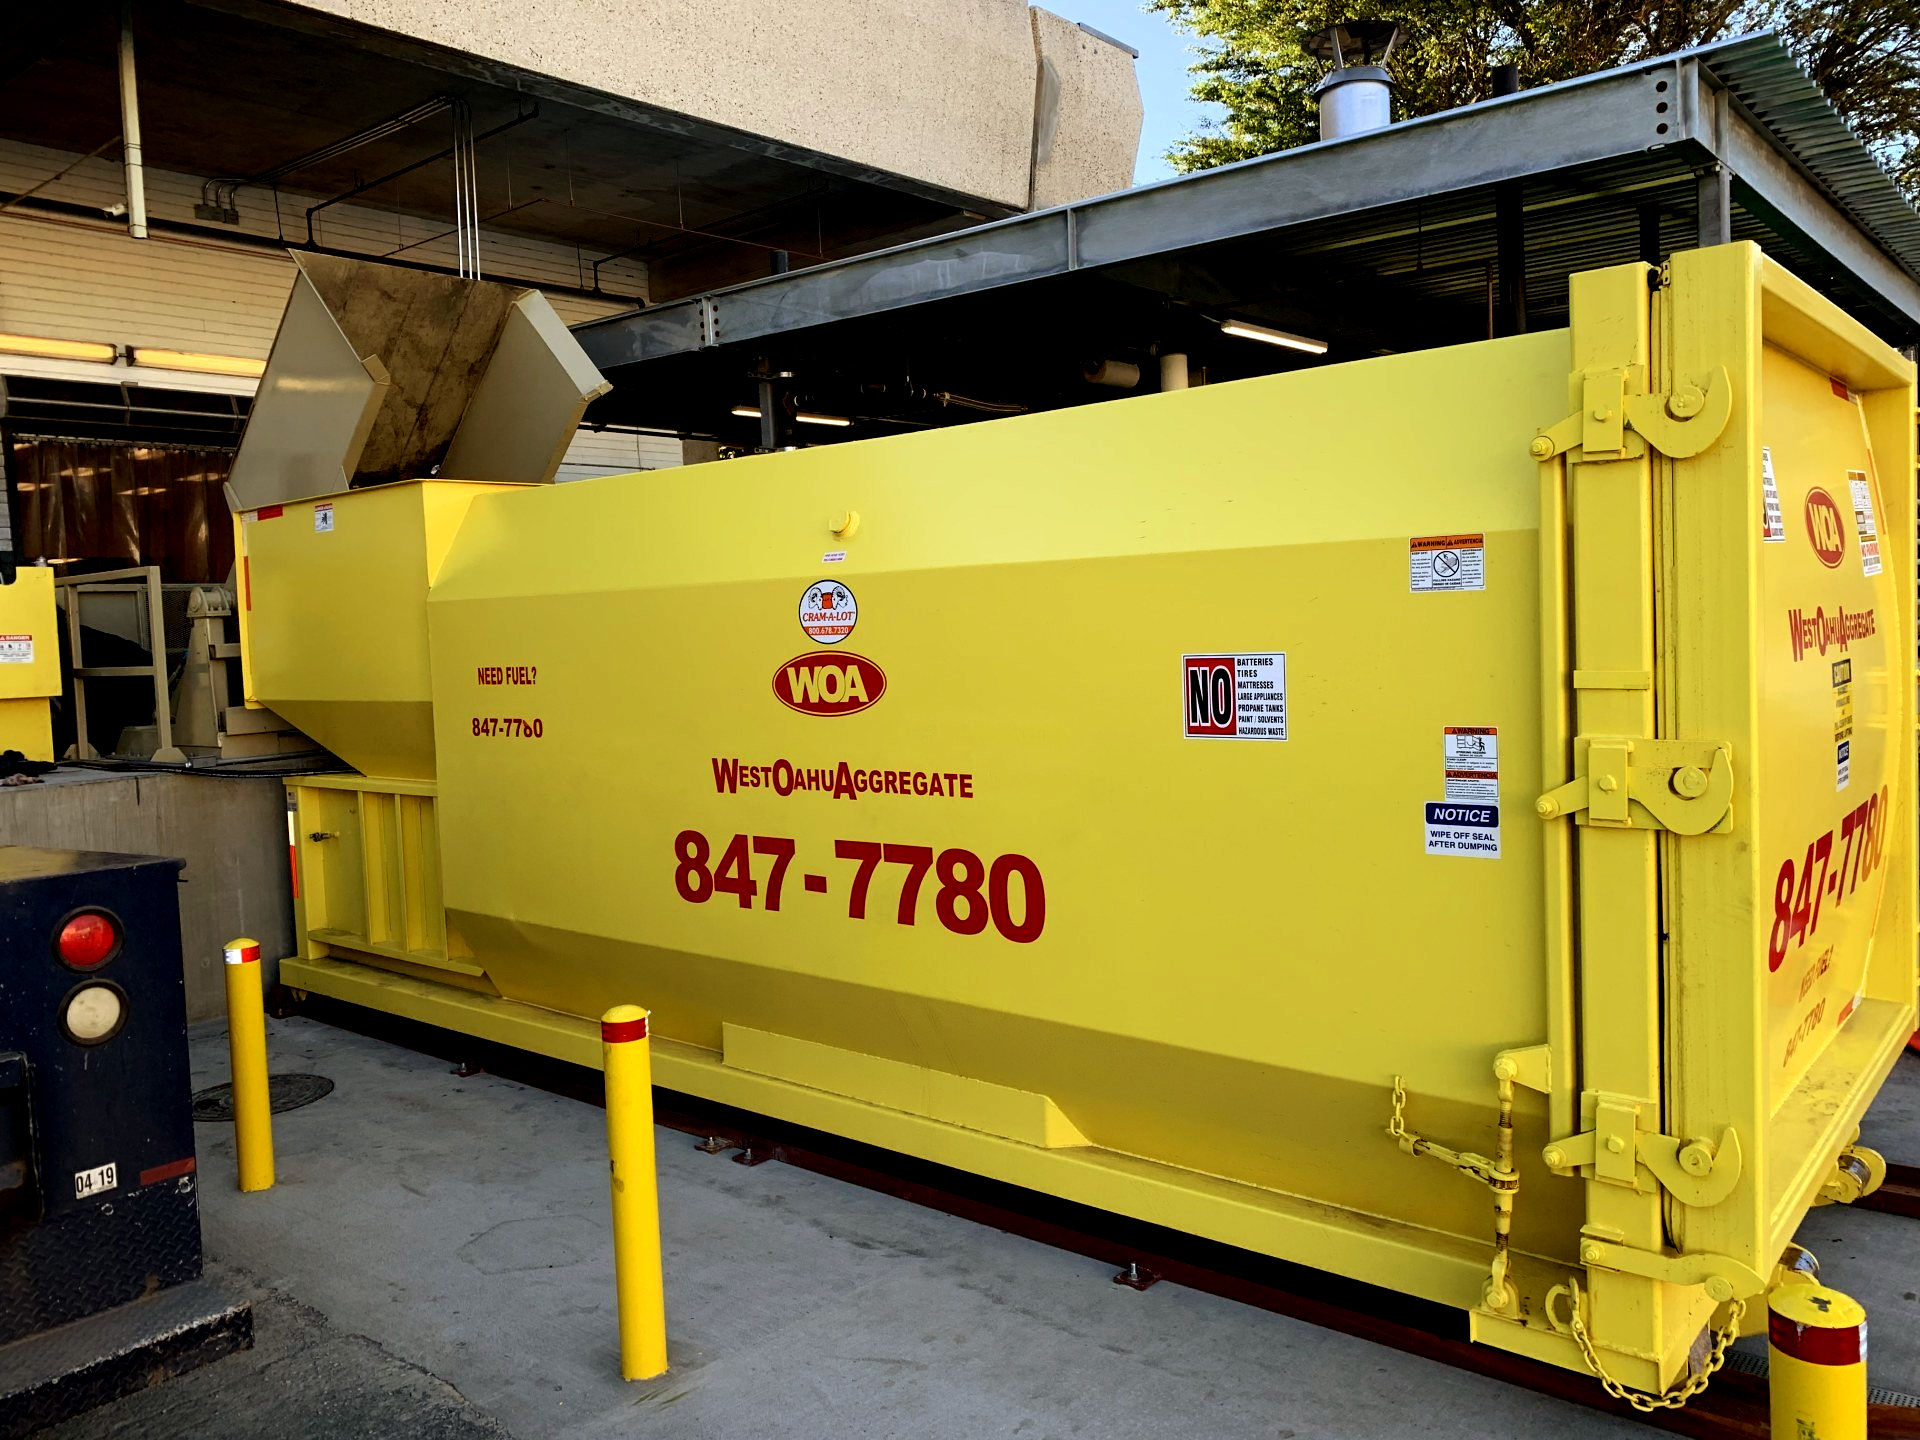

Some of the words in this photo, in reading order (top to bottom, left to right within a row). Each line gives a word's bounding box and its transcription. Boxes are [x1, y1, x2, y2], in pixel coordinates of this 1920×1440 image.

[1808, 502, 1843, 553] WOA
[802, 611, 853, 622] CRAM-A-LOT
[808, 626, 849, 635] 800.678.7320
[1237, 658, 1273, 666] BATTERIES
[477, 667, 503, 685] NEED
[505, 666, 537, 685] FUEL?
[786, 664, 870, 704] WOA
[1237, 681, 1274, 689] MATTRESSES
[1188, 665, 1233, 728] NO
[1253, 693, 1283, 701] APPLIANCES
[1238, 704, 1264, 712] PROPANE
[1265, 704, 1284, 713] TANKS
[1257, 716, 1284, 724] SOLVENTS
[1238, 727, 1267, 735] HAZARDOUS
[1268, 727, 1284, 736] WASTE
[1453, 771, 1497, 779] ADVERTENCIA
[1433, 808, 1491, 823] NOTICE
[1430, 830, 1451, 839] WIPE
[1453, 831, 1470, 840] OFF
[1472, 833, 1495, 842] SEAL
[1428, 840, 1456, 849] AFTER
[1458, 841, 1498, 852] DUMPING
[1768, 784, 1888, 973] 847-7780
[674, 829, 1046, 943] 847-7780
[76, 1173, 92, 1193] 04
[98, 1167, 114, 1186] 19
